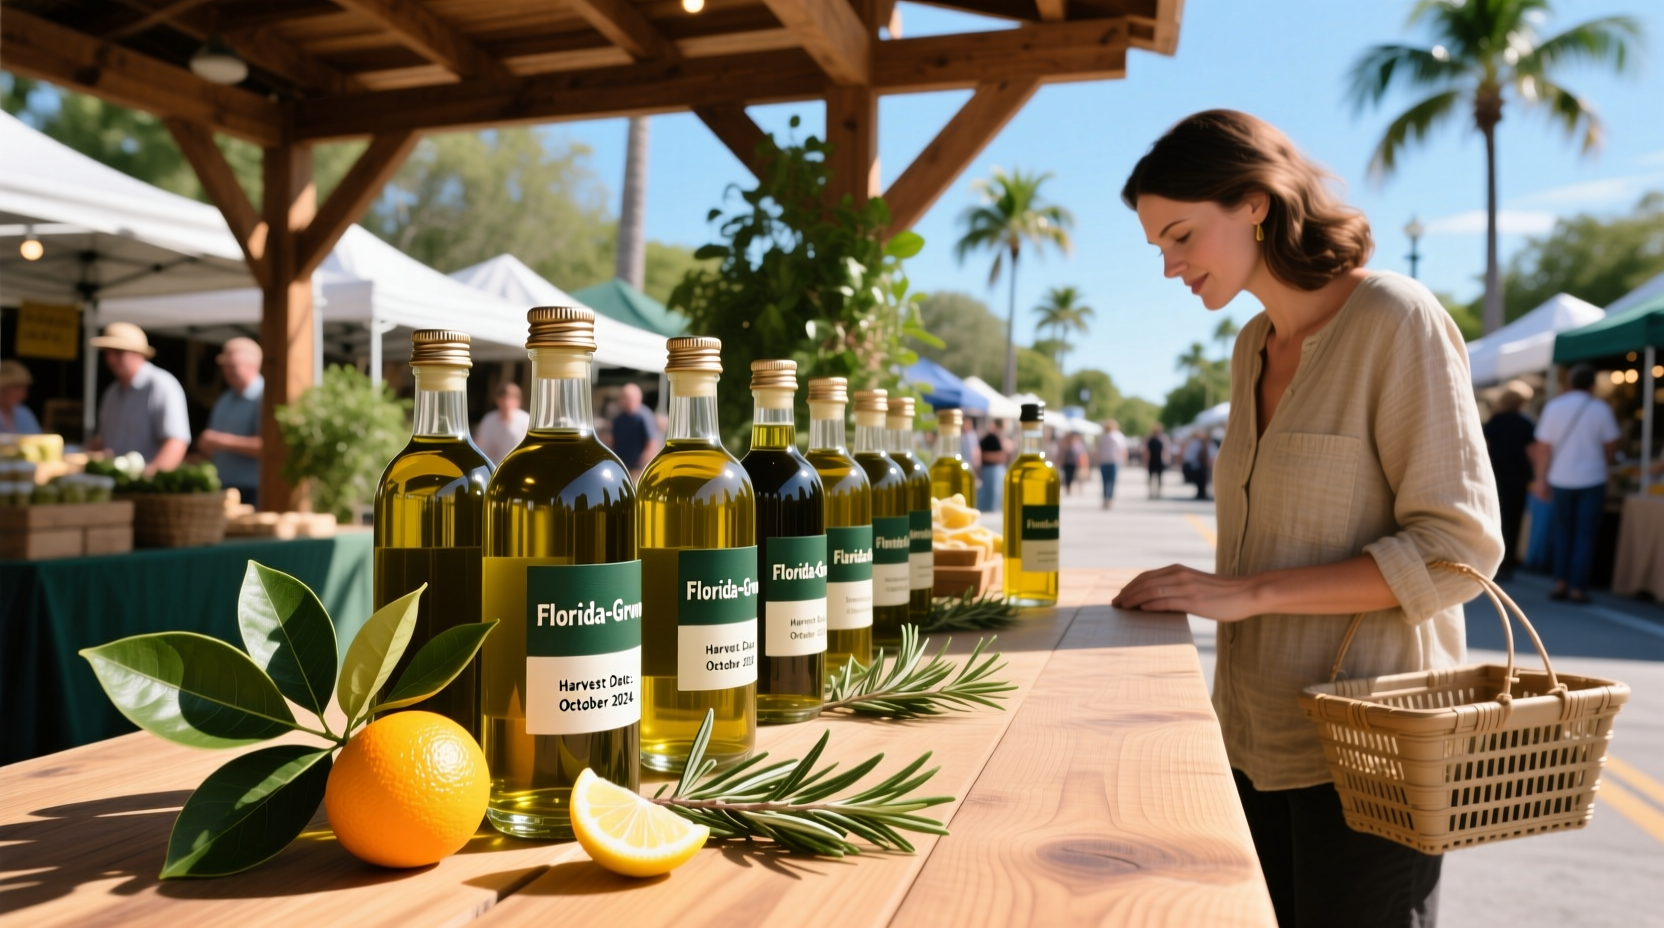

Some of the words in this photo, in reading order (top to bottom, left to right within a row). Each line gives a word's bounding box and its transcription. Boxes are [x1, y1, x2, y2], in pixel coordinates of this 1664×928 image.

[559, 677, 607, 692] Harvest
[558, 697, 609, 712] October
[611, 691, 634, 707] 2024
